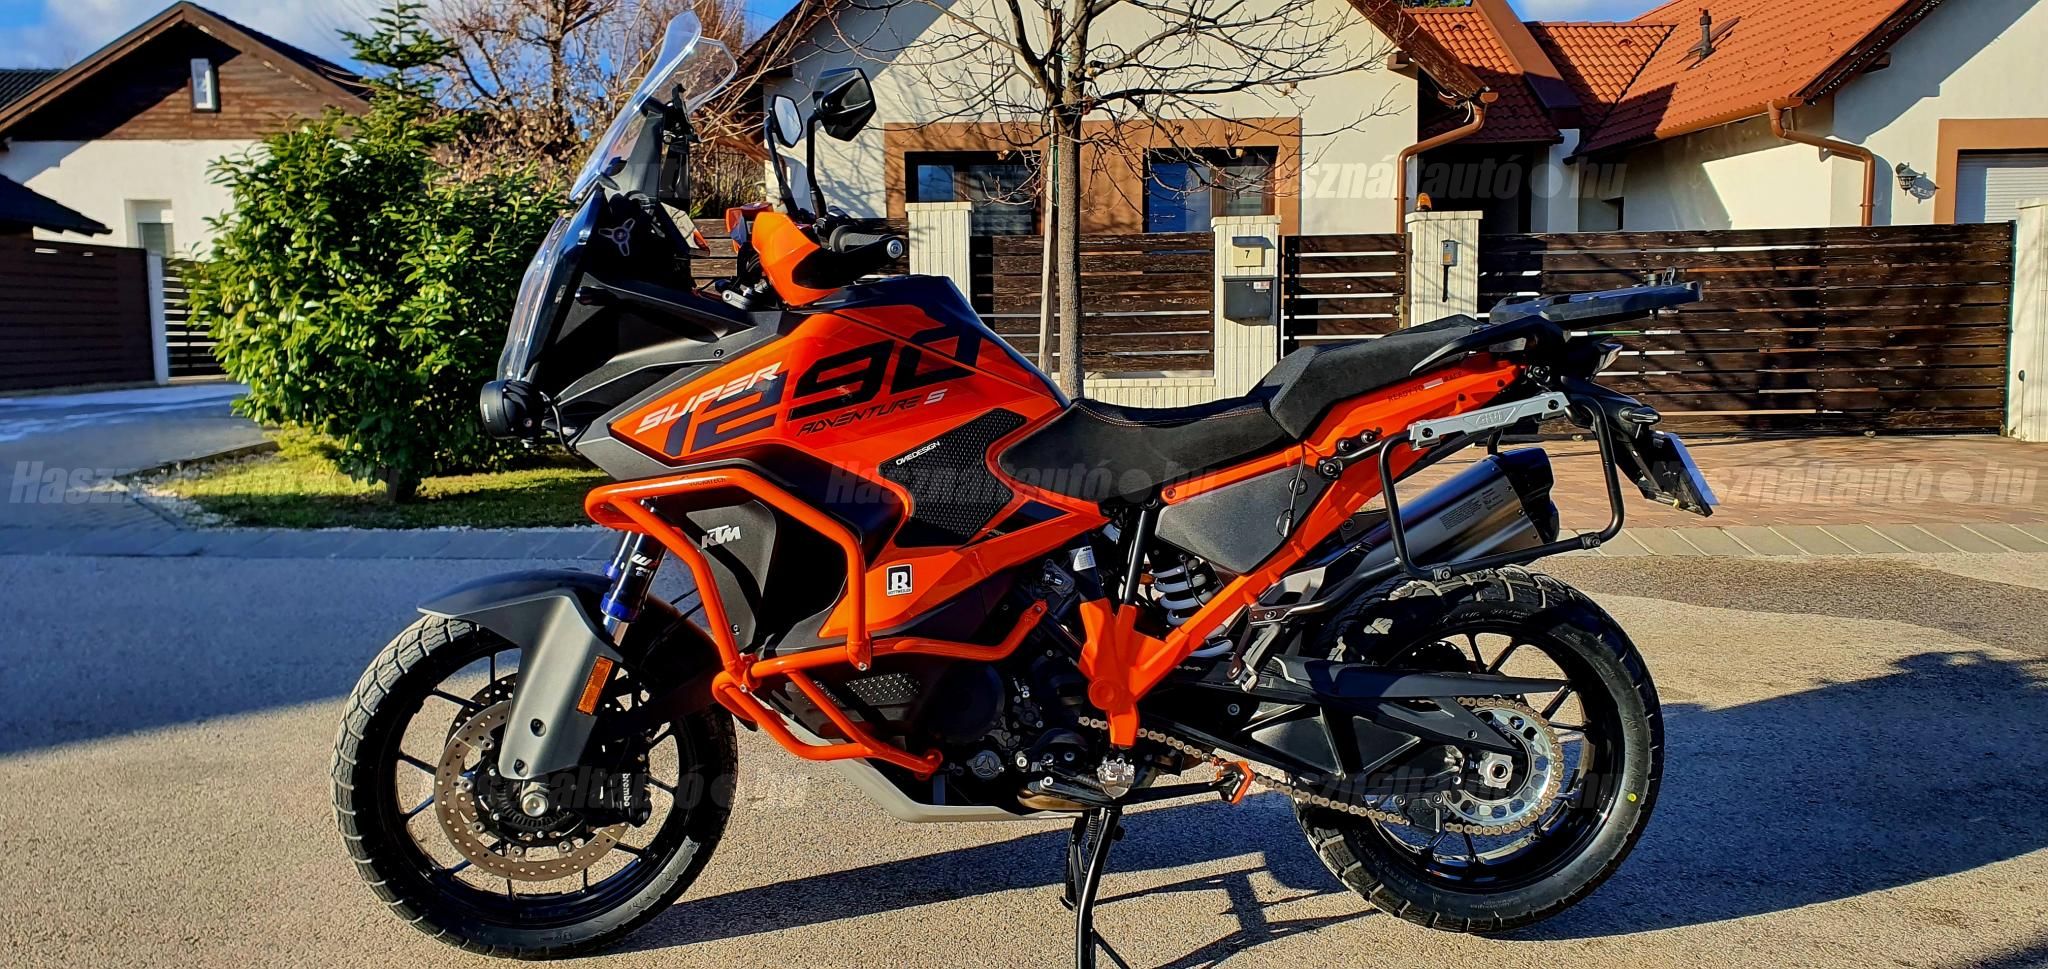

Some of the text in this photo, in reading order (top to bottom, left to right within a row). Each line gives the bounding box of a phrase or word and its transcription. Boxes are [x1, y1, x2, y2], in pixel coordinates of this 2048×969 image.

[1244, 249, 1251, 259] 7
[634, 361, 782, 435] SUPER
[796, 389, 948, 437] ADVENTURE S
[895, 440, 940, 466] ONEDESIGN
[701, 525, 741, 549] KTM
[622, 772, 632, 807] brembo
